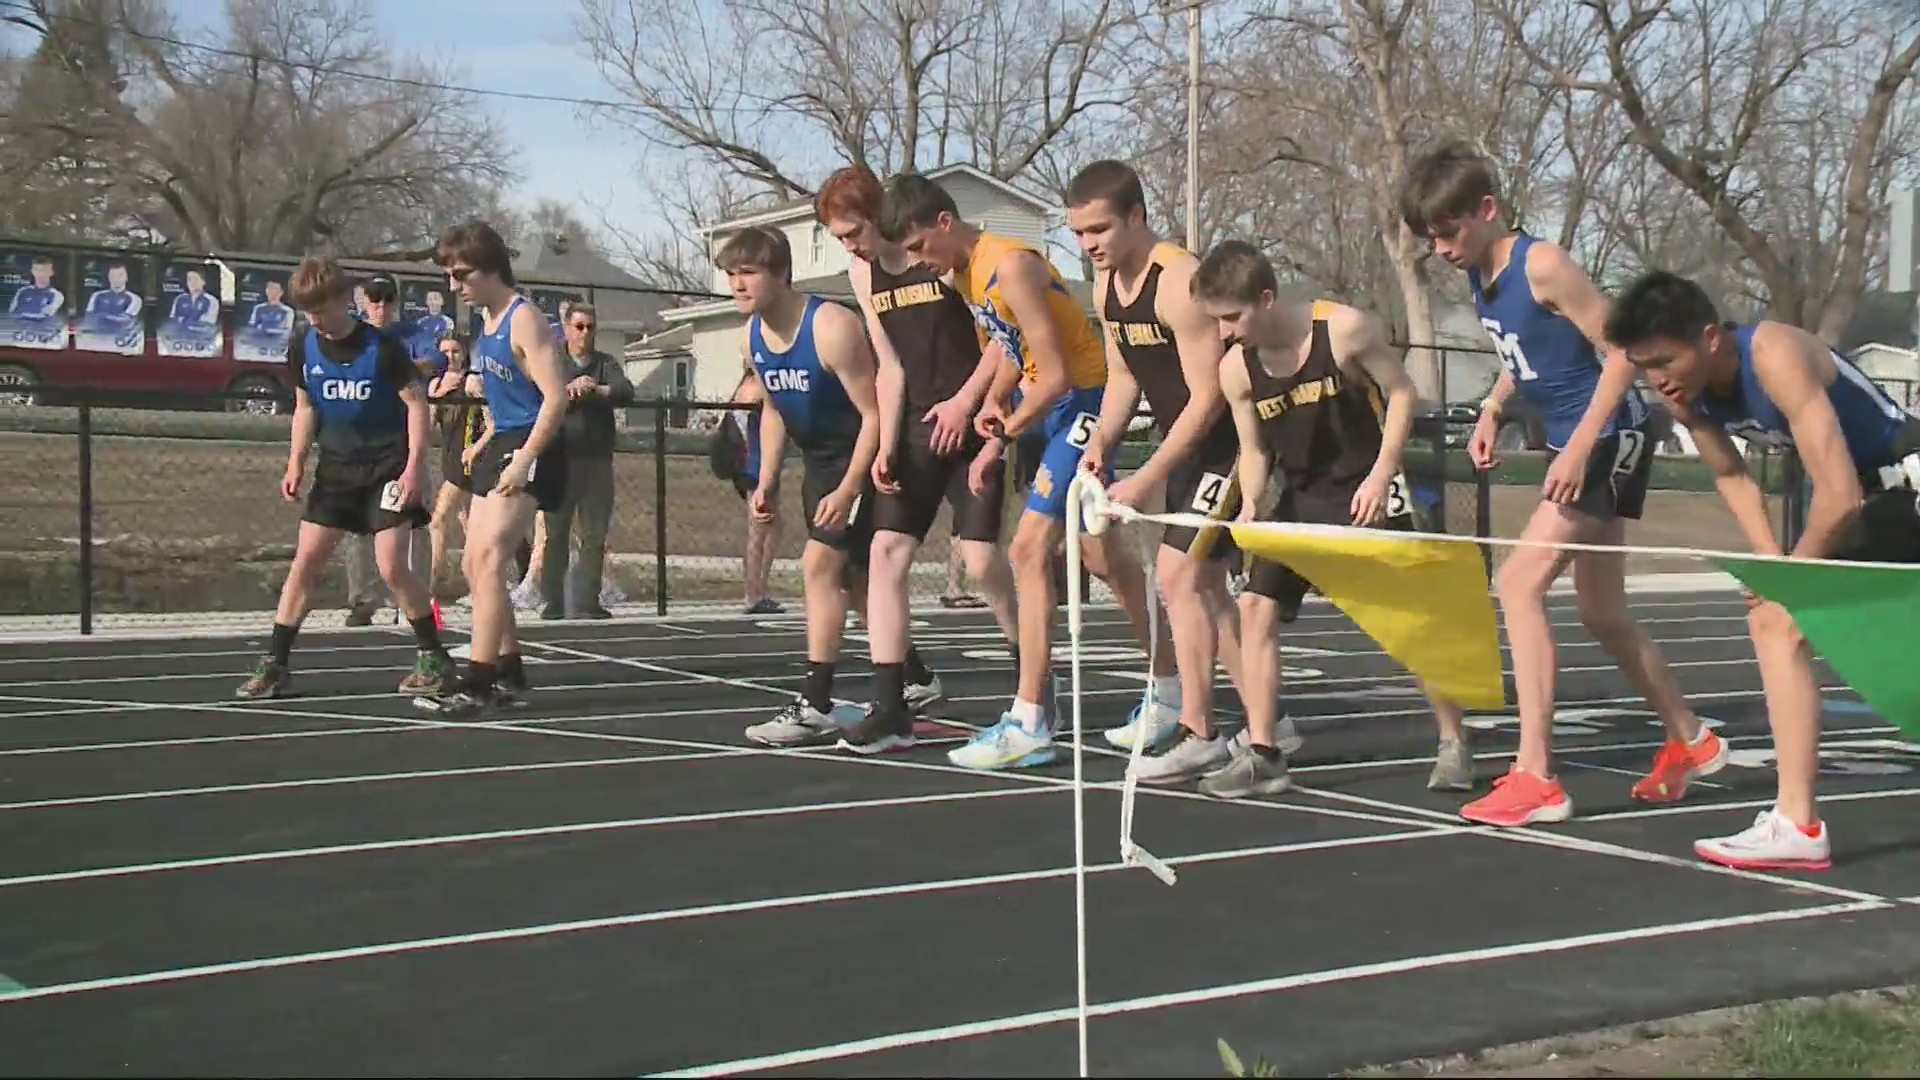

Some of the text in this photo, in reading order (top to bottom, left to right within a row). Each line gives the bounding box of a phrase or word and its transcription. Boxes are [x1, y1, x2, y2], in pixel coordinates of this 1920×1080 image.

[322, 379, 372, 401] GMG
[763, 368, 811, 392] GMG
[1073, 416, 1097, 446] 5
[1616, 432, 1637, 469] 2
[389, 483, 402, 506] 9
[1200, 478, 1223, 510] 4
[1389, 480, 1405, 514] 3
